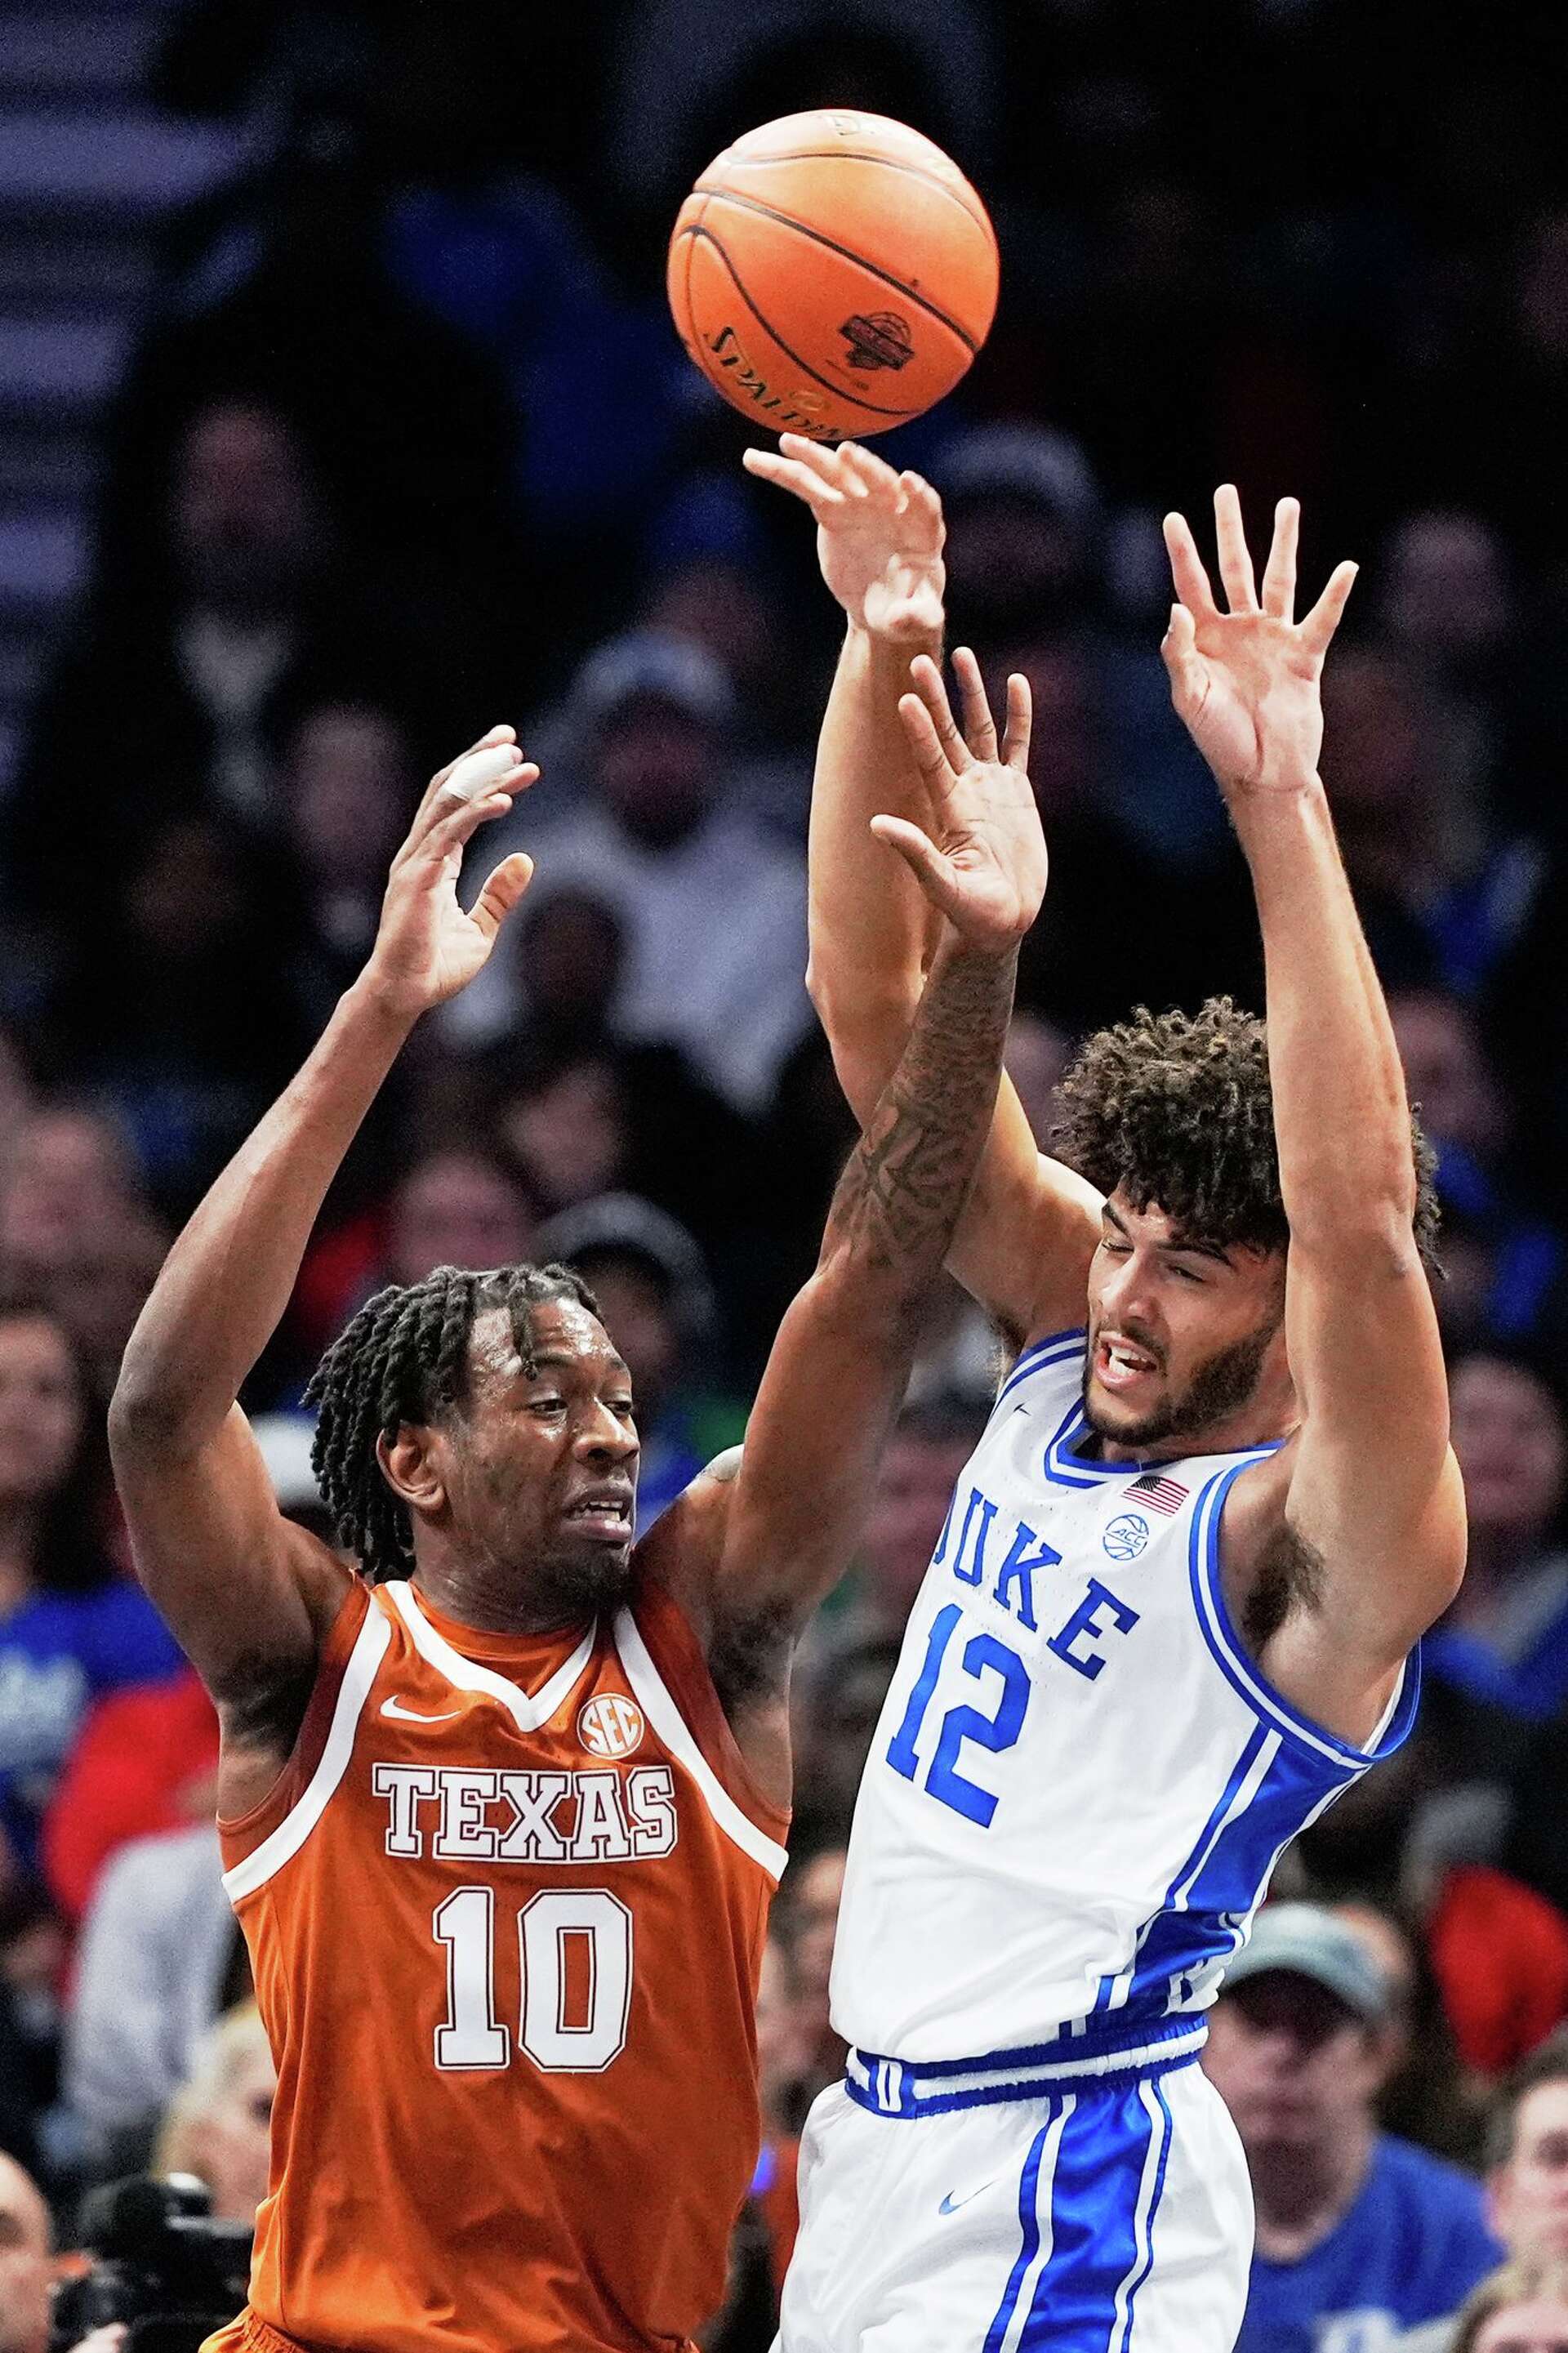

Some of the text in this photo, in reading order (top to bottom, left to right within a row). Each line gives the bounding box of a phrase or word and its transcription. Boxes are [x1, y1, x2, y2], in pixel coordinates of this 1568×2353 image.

[933, 1486, 1140, 1681] UKE
[1111, 1528, 1147, 1546] ACC
[581, 1698, 639, 1755] SEC
[885, 1603, 1031, 1829] 12
[372, 1763, 678, 1865] TEXAS
[432, 1885, 634, 2073] 10
